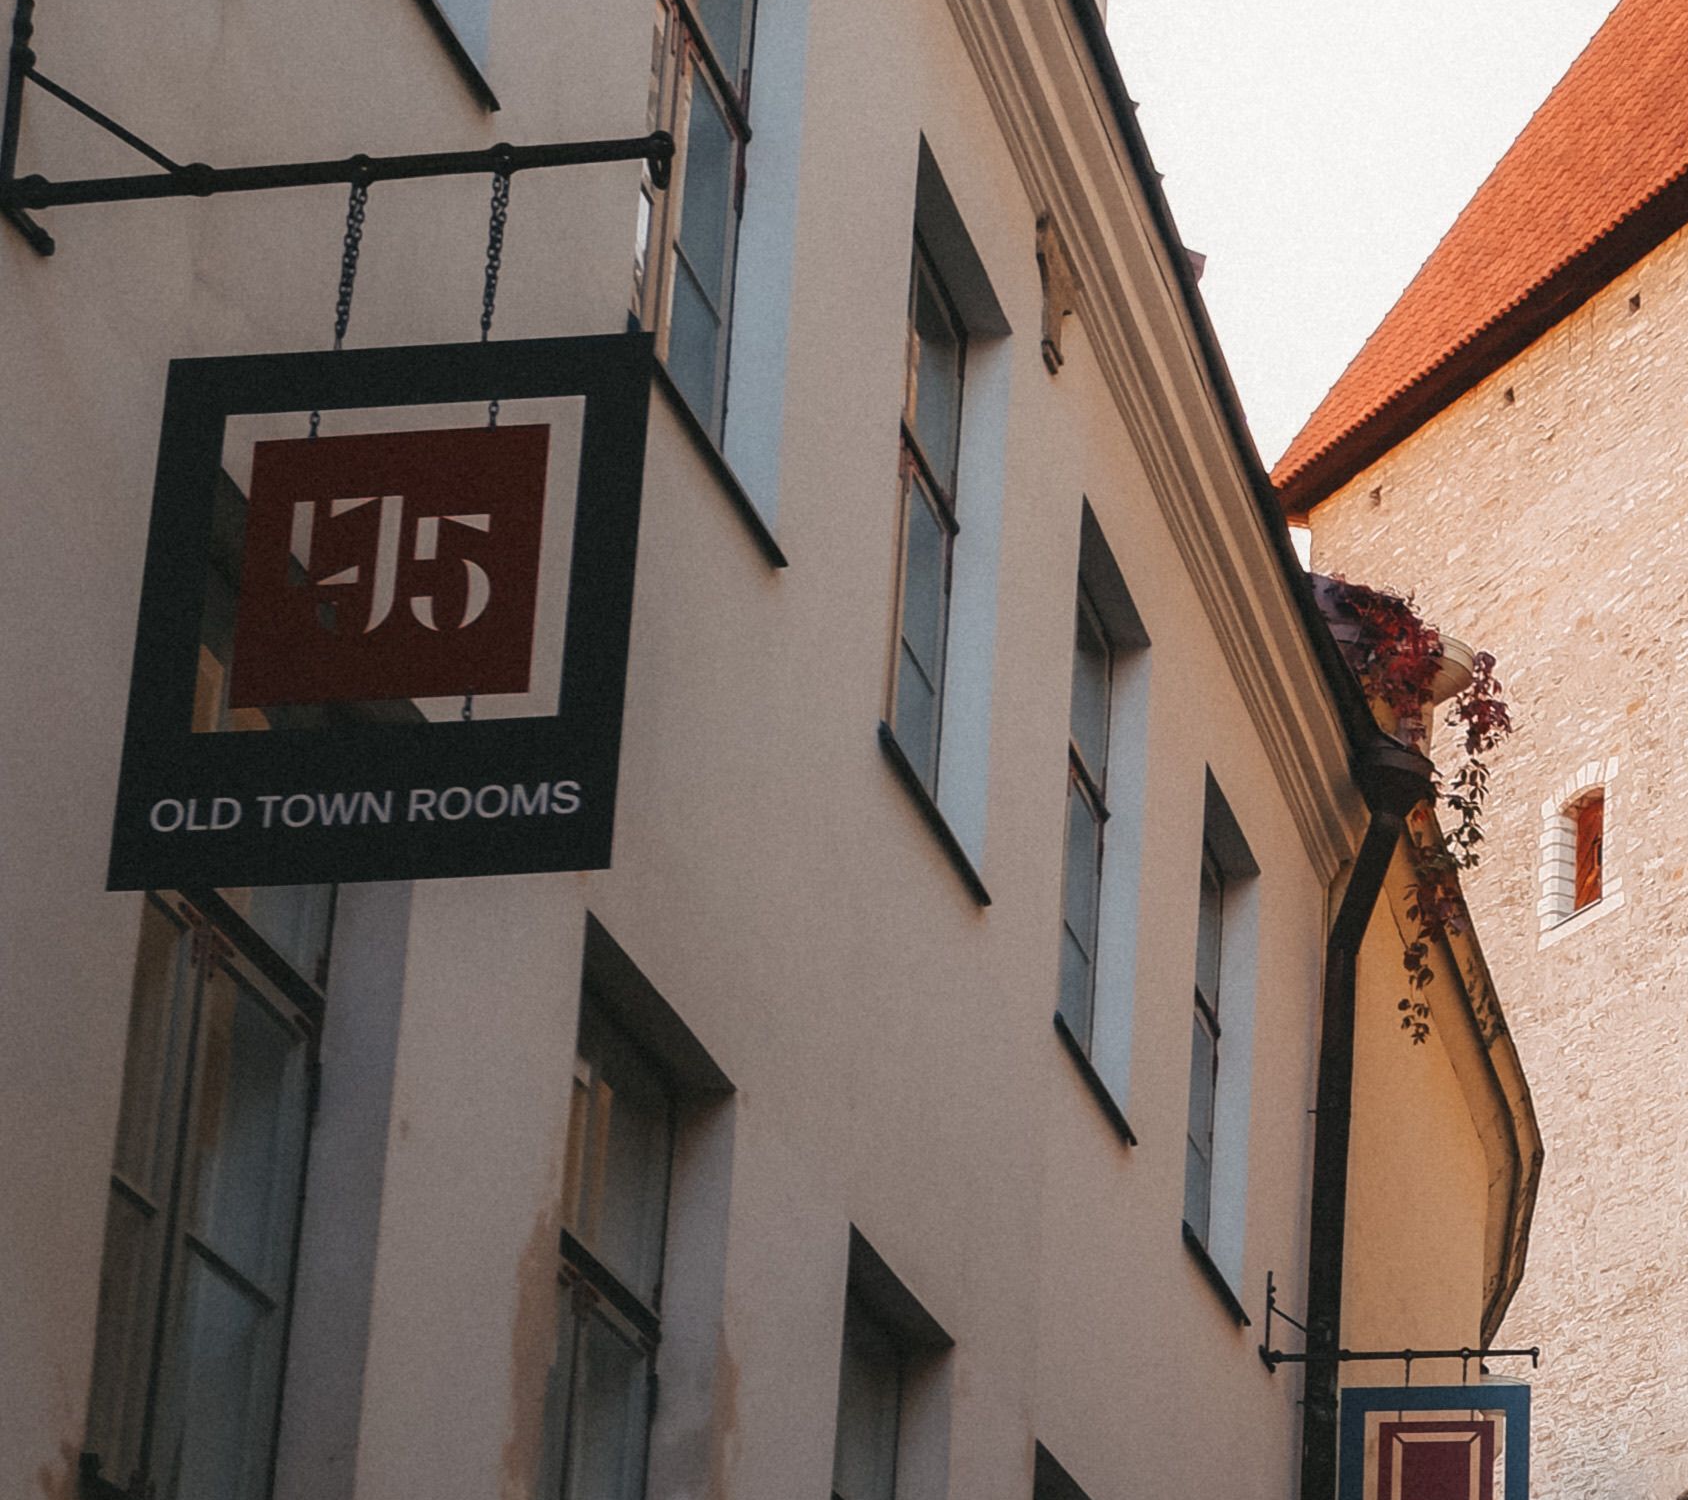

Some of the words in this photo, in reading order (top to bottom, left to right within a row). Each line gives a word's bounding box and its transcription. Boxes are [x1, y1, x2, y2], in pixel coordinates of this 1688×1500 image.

[149, 798, 242, 832] OLD
[257, 791, 393, 827] TOWN
[407, 781, 581, 821] ROOMS
